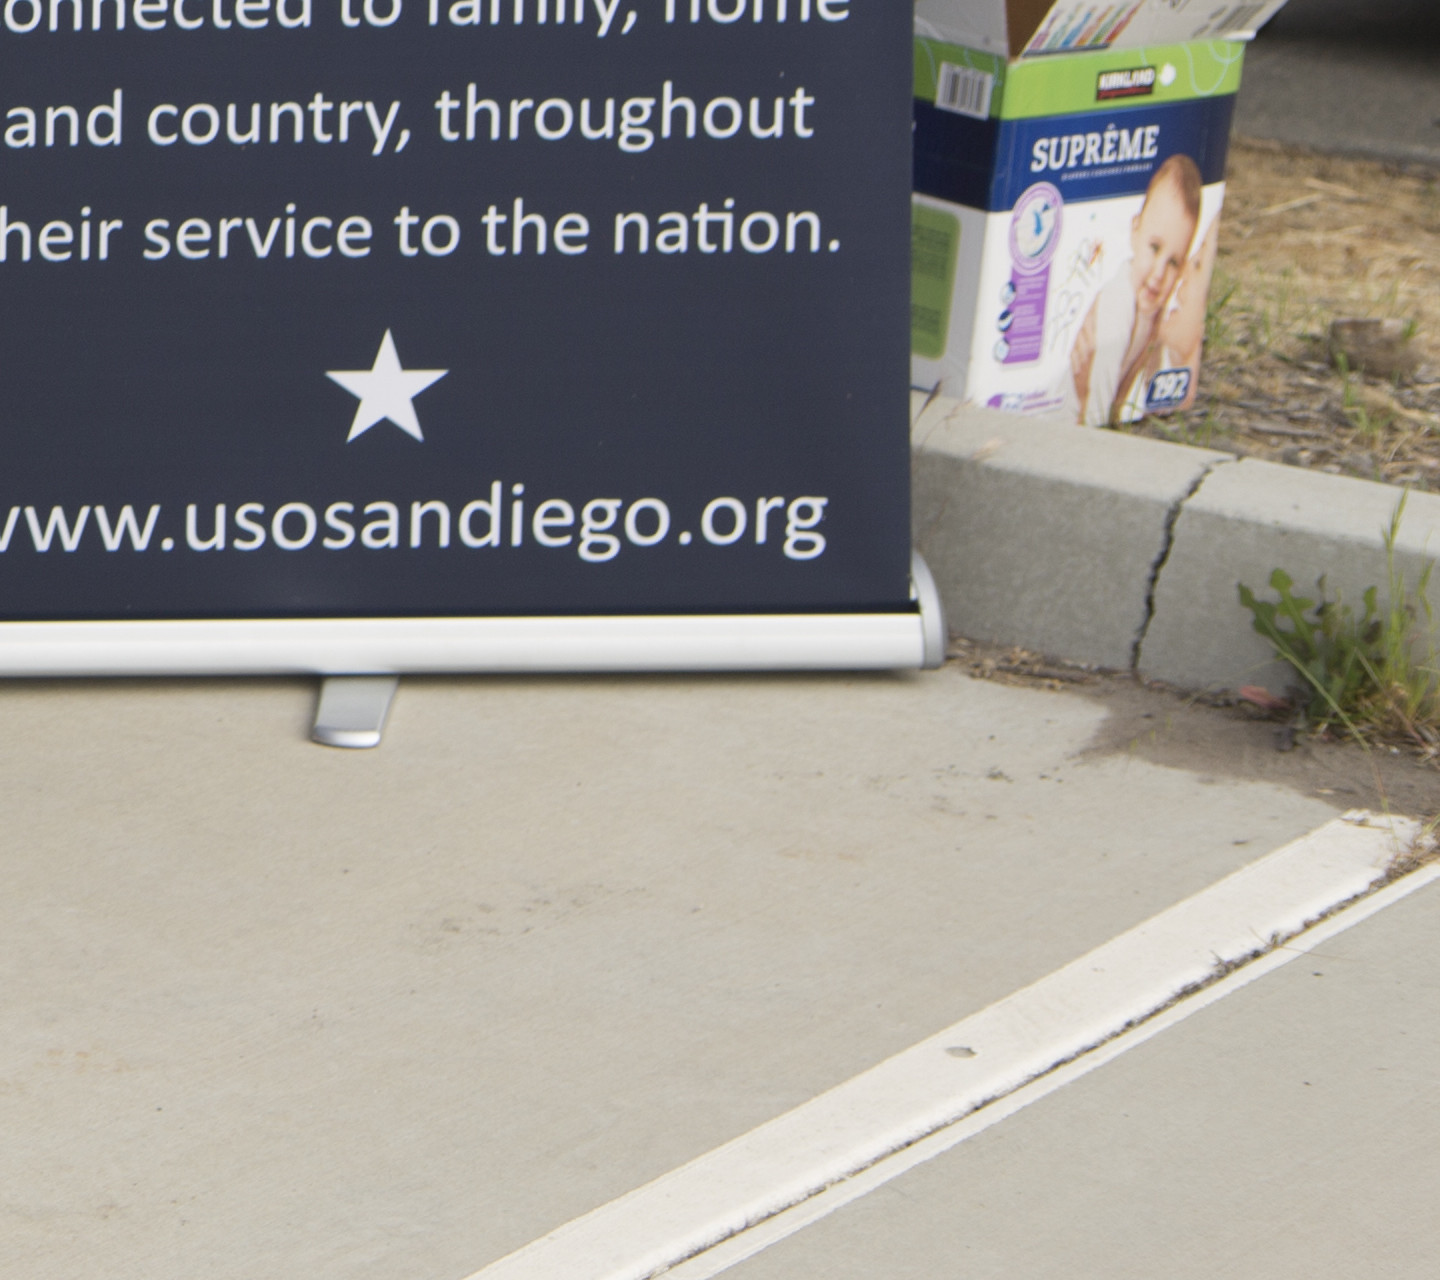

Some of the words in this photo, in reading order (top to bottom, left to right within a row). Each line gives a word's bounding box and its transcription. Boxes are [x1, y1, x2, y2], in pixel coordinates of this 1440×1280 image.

[1099, 68, 1155, 90] KIRKLAND
[4, 89, 122, 147] and
[148, 93, 410, 155] country,
[435, 81, 814, 152] throughout
[144, 203, 372, 260] service
[394, 207, 460, 257] to
[482, 198, 589, 255] the
[615, 198, 839, 254] nation.
[1151, 370, 1189, 400] 192
